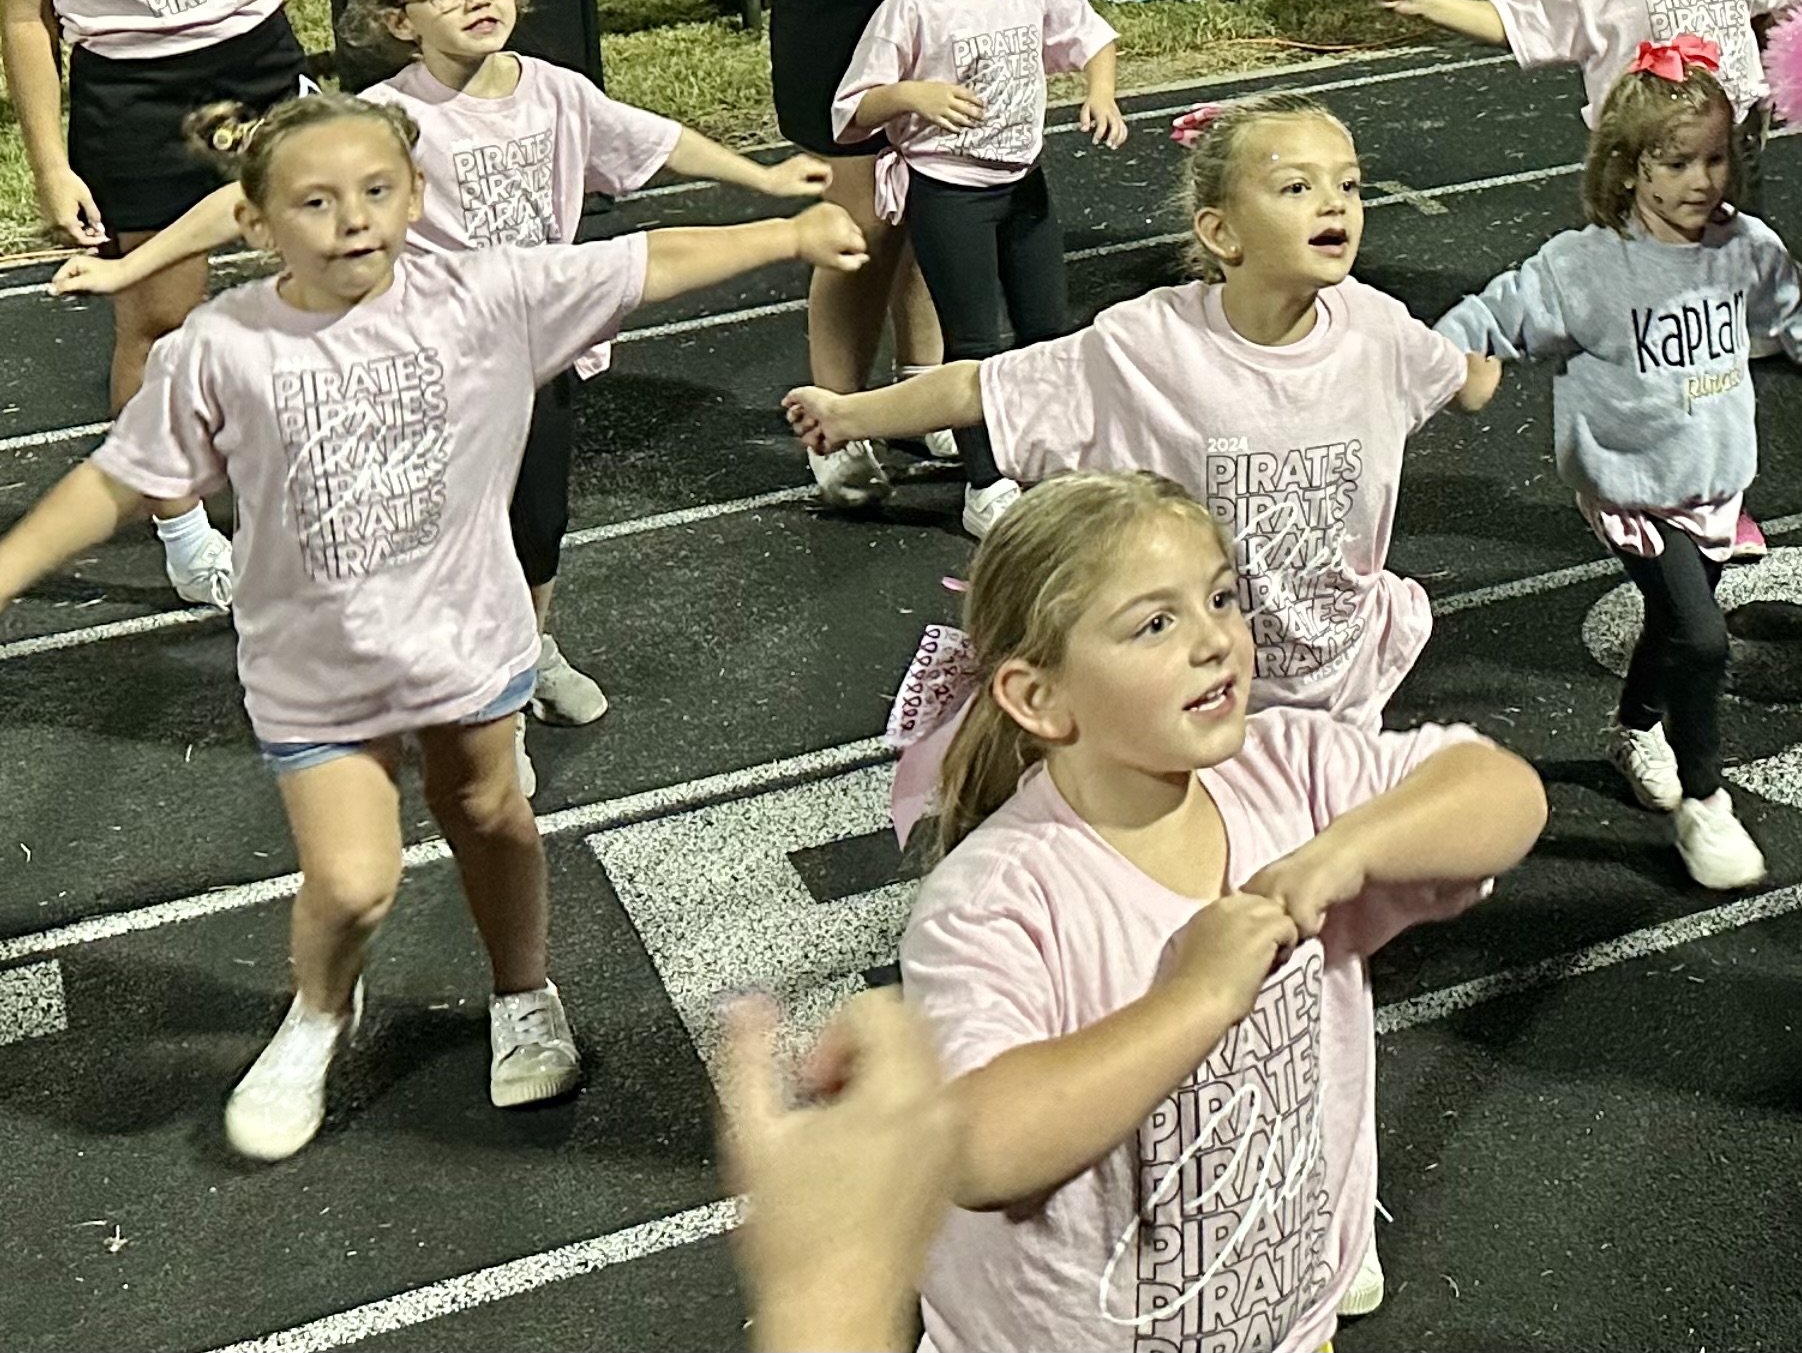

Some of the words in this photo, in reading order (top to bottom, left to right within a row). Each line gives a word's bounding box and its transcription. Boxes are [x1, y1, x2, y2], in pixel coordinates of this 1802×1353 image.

[952, 24, 1038, 67] PIRATES
[273, 347, 443, 408] PIRATES
[277, 383, 448, 444] PIRATES
[1207, 439, 1362, 495] PIRATES
[1208, 436, 1250, 452] 2024
